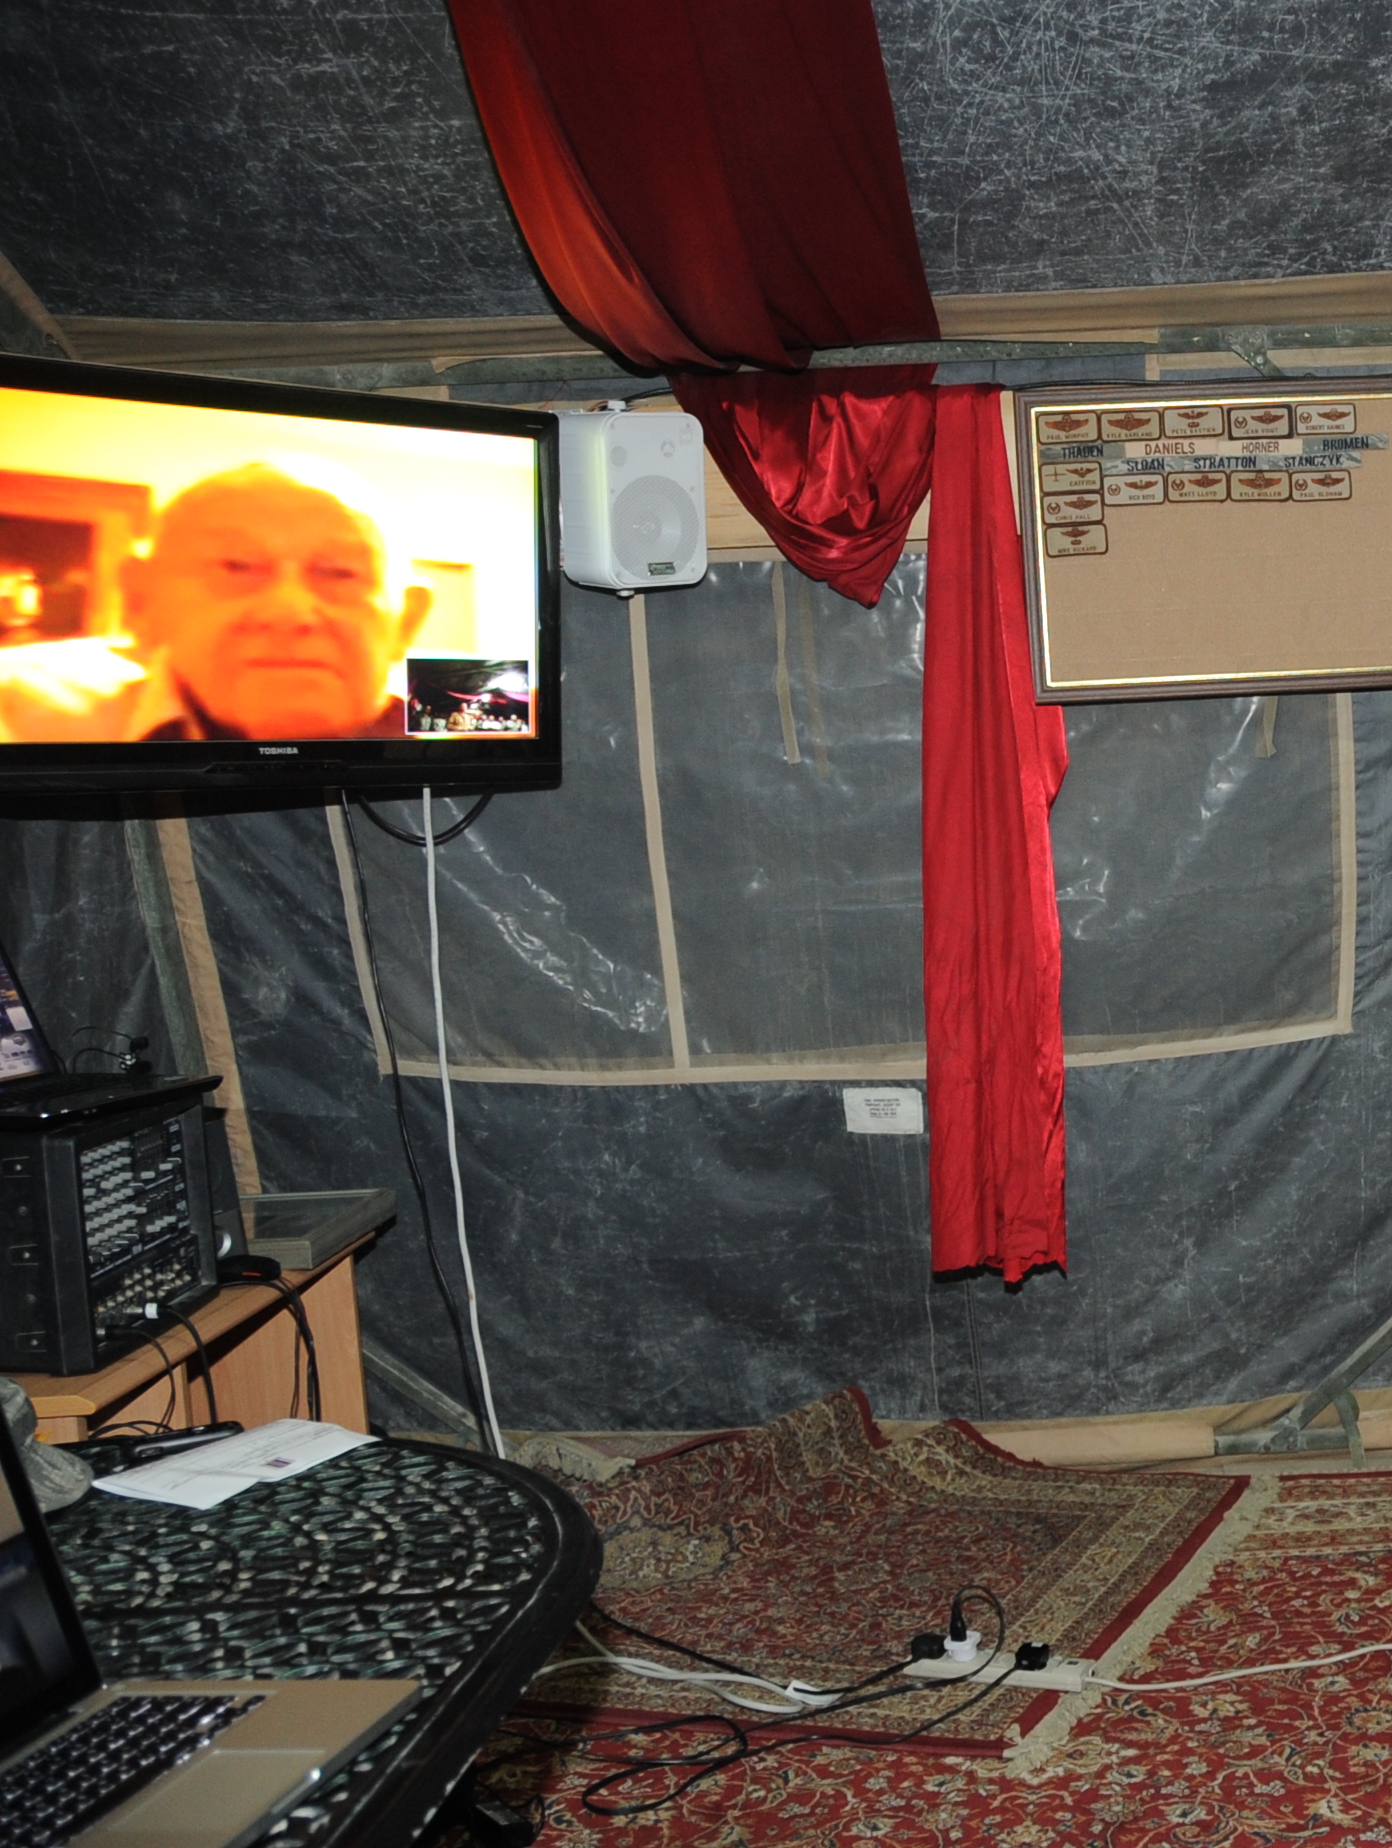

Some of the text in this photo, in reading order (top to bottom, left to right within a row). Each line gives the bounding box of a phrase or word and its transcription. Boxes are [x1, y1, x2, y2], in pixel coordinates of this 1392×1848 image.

[1144, 441, 1196, 456] DANIELS
[1241, 441, 1280, 454] HORNER
[1322, 436, 1370, 451] BROMEN
[1061, 445, 1104, 459] THADEN
[1126, 459, 1165, 472] SLOAN
[1193, 456, 1257, 470] STRATTON
[1283, 453, 1343, 468] STANCZYK
[258, 746, 299, 755] TOSHIBA
